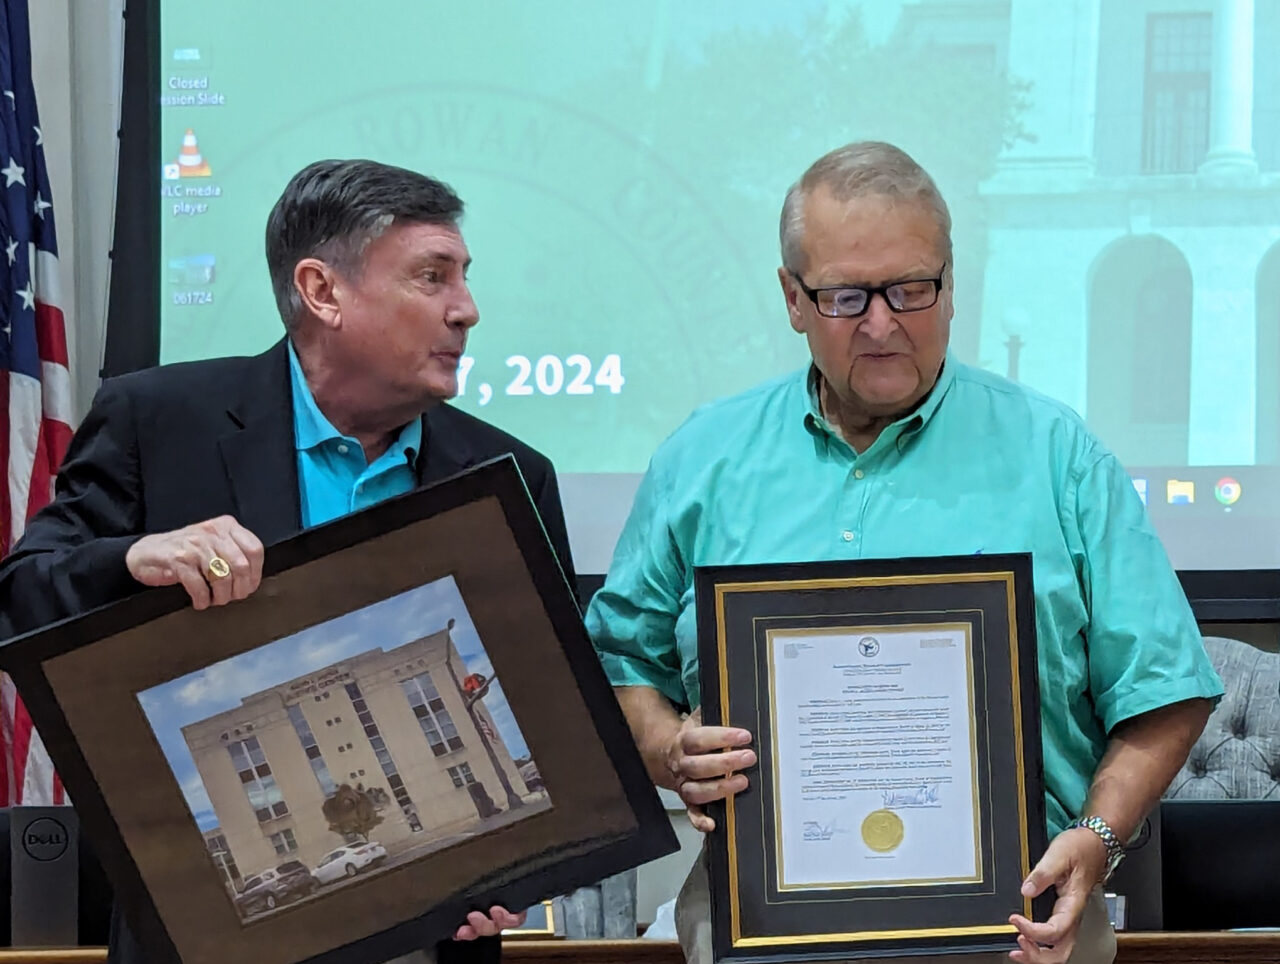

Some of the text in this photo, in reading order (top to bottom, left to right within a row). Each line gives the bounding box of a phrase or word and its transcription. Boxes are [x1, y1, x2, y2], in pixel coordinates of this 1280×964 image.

[168, 76, 208, 90] Closed
[198, 92, 226, 106] Slide
[352, 98, 556, 168] ROWAN
[185, 184, 221, 197] media
[173, 201, 208, 216] player
[505, 354, 625, 396] 2024
[28, 834, 62, 845] DELL
